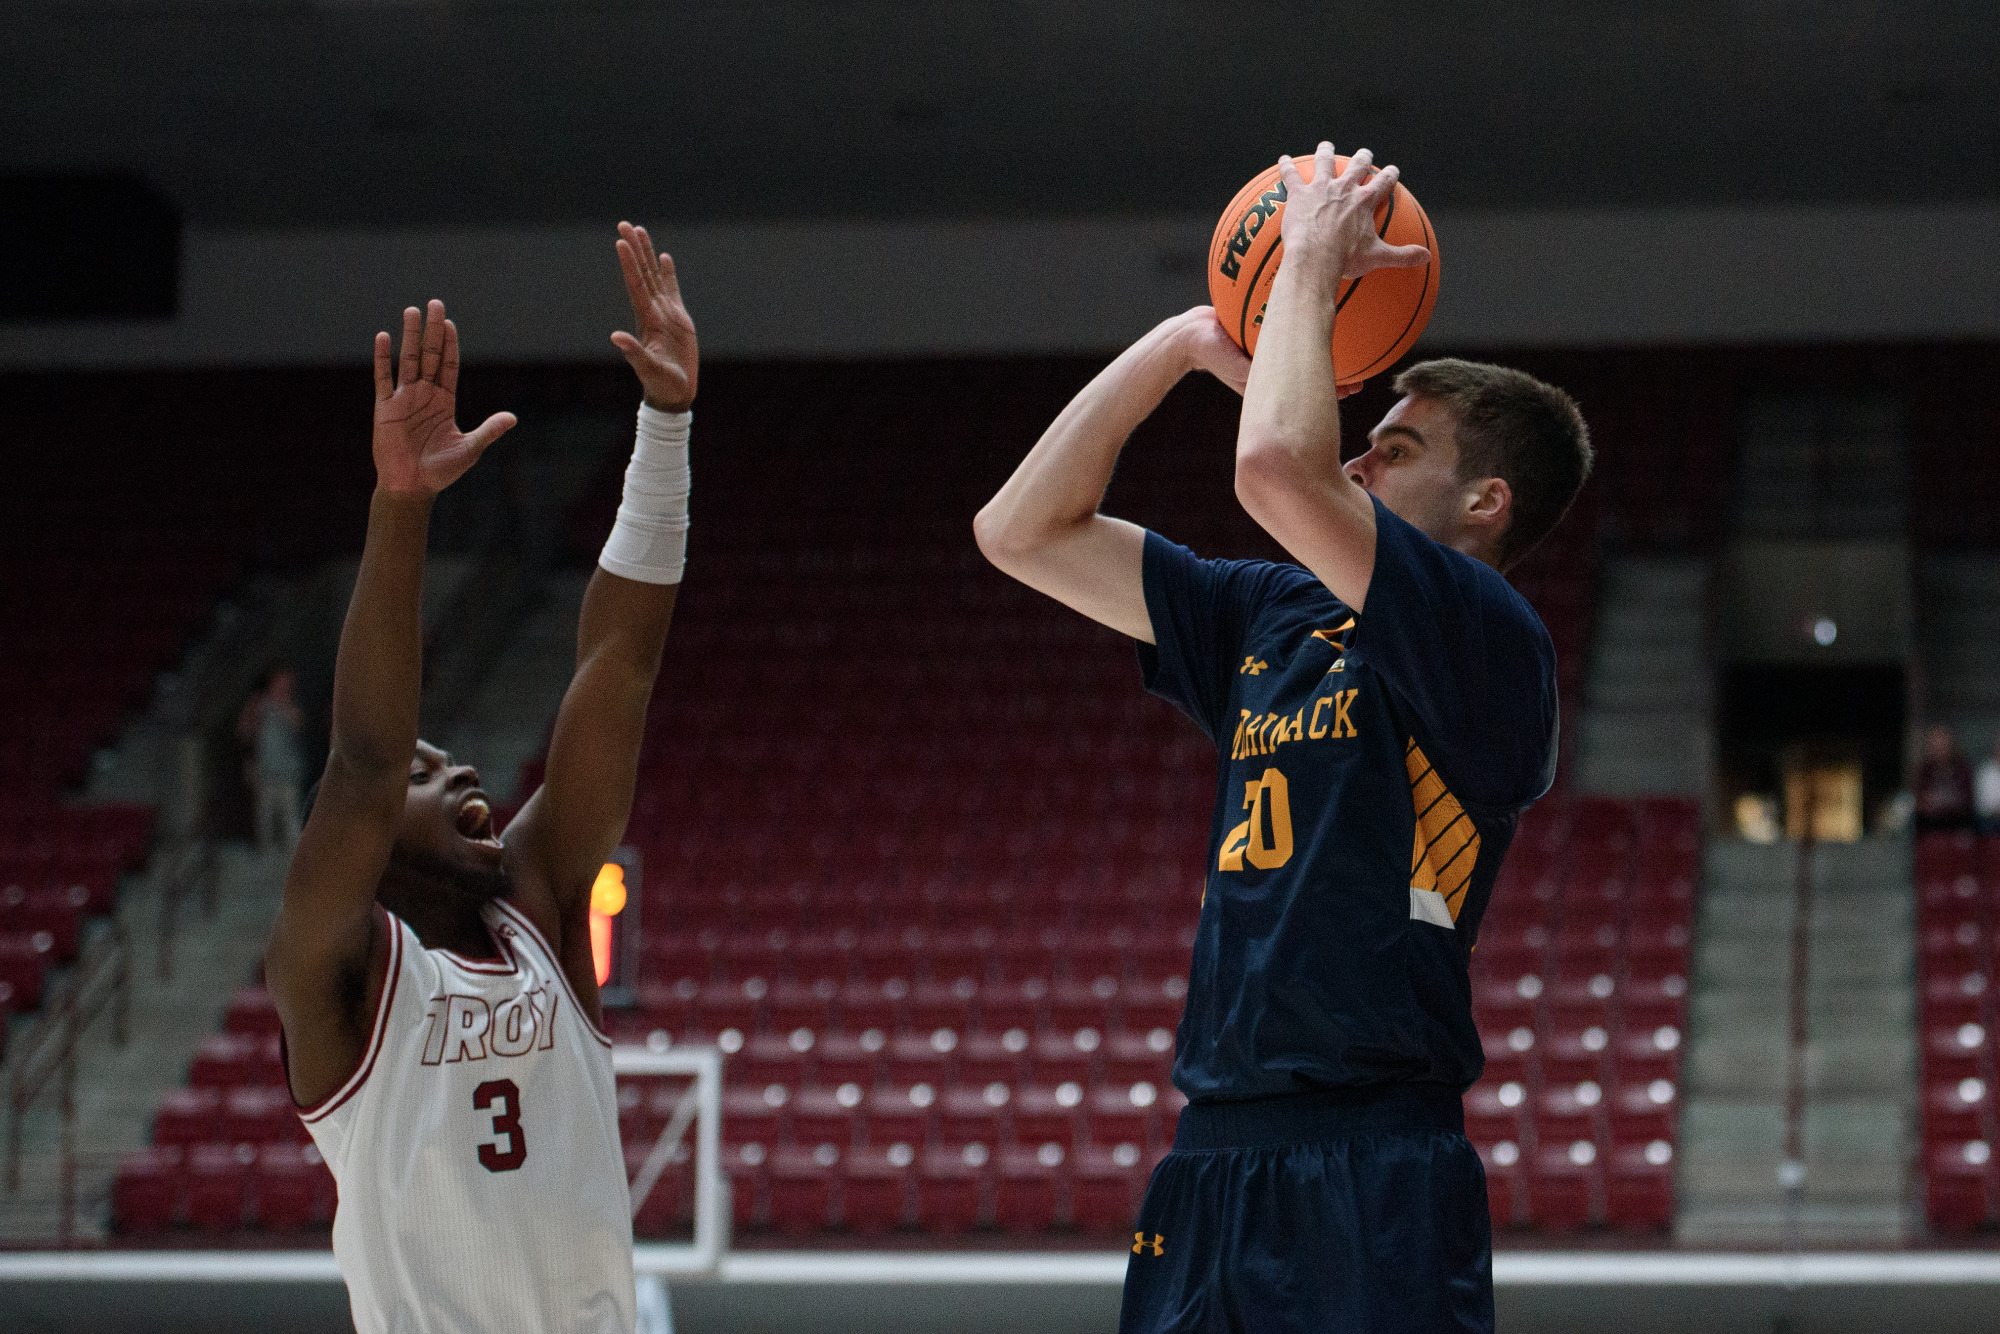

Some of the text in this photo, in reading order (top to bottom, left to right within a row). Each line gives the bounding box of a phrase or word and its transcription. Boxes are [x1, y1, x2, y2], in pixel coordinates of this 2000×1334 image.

[1220, 180, 1288, 281] NCAA
[1218, 767, 1294, 872] 20
[421, 979, 559, 1066] TROY
[472, 1078, 528, 1174] 3
